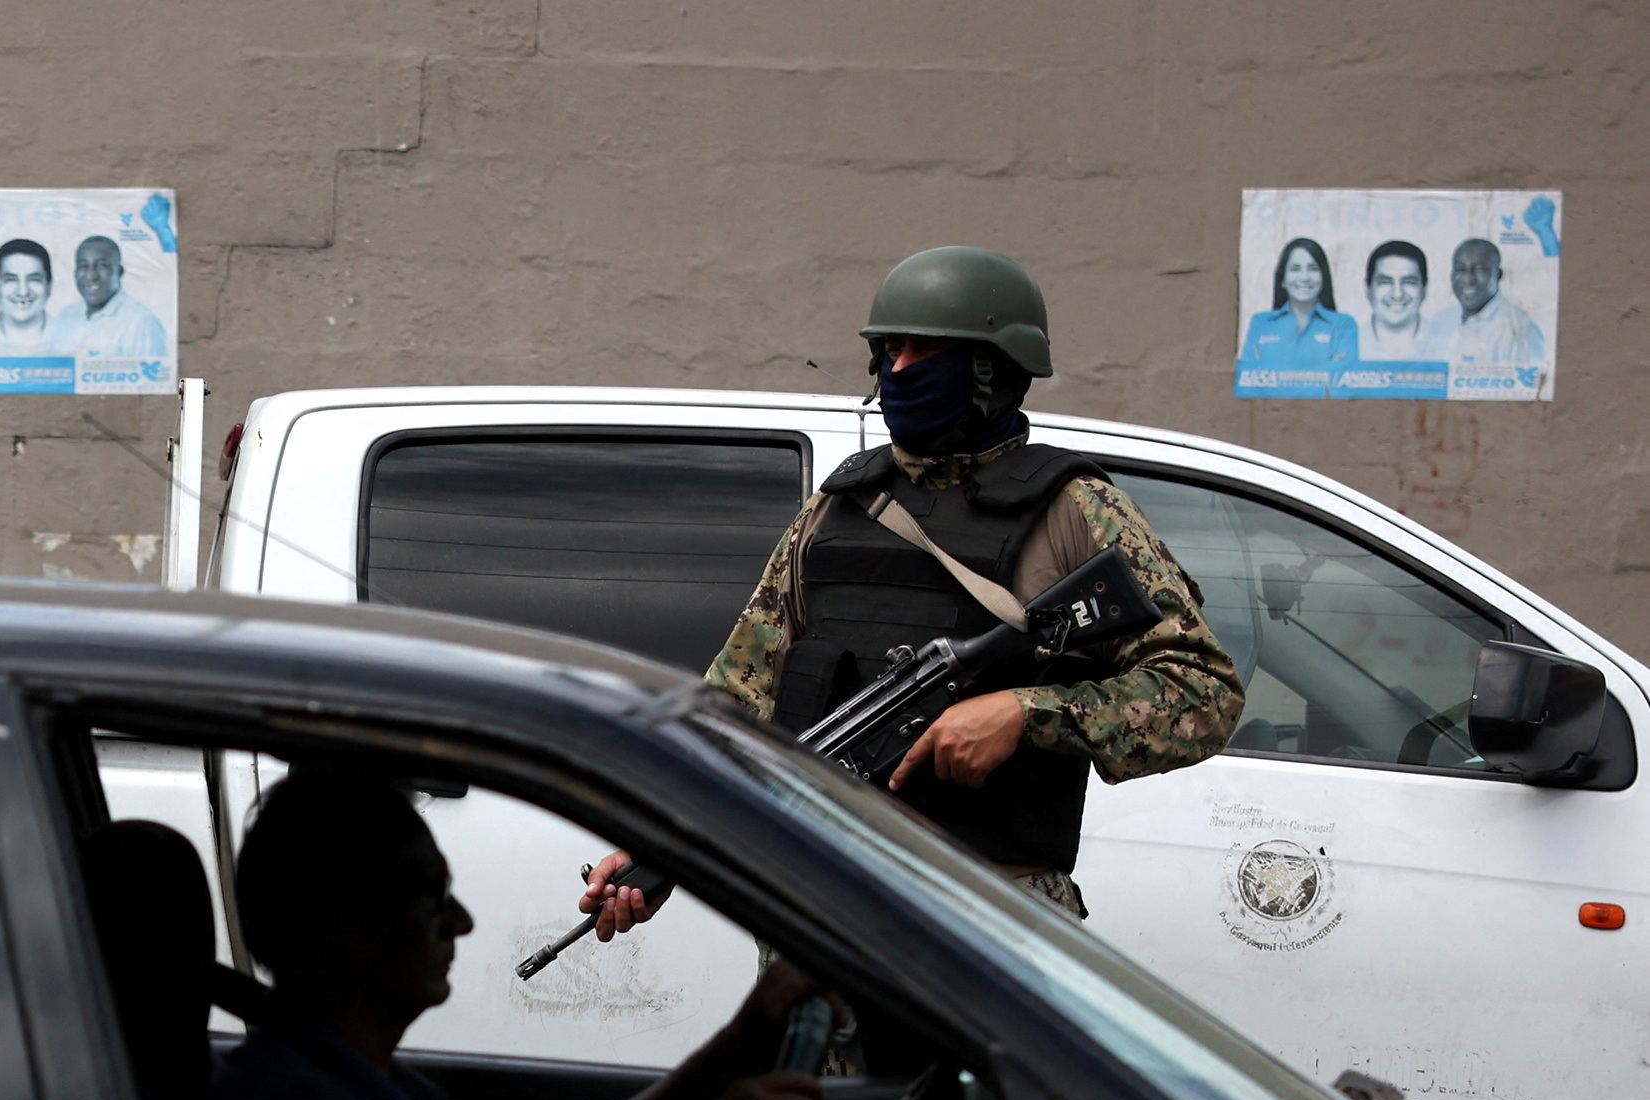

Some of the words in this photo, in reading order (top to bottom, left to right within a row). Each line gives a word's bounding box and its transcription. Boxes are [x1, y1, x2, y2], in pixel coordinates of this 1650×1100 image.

[1256, 199, 1441, 230] DISTRITO
[81, 372, 140, 383] CUERO
[1454, 377, 1515, 389] CUERO
[1070, 596, 1101, 628] 21
